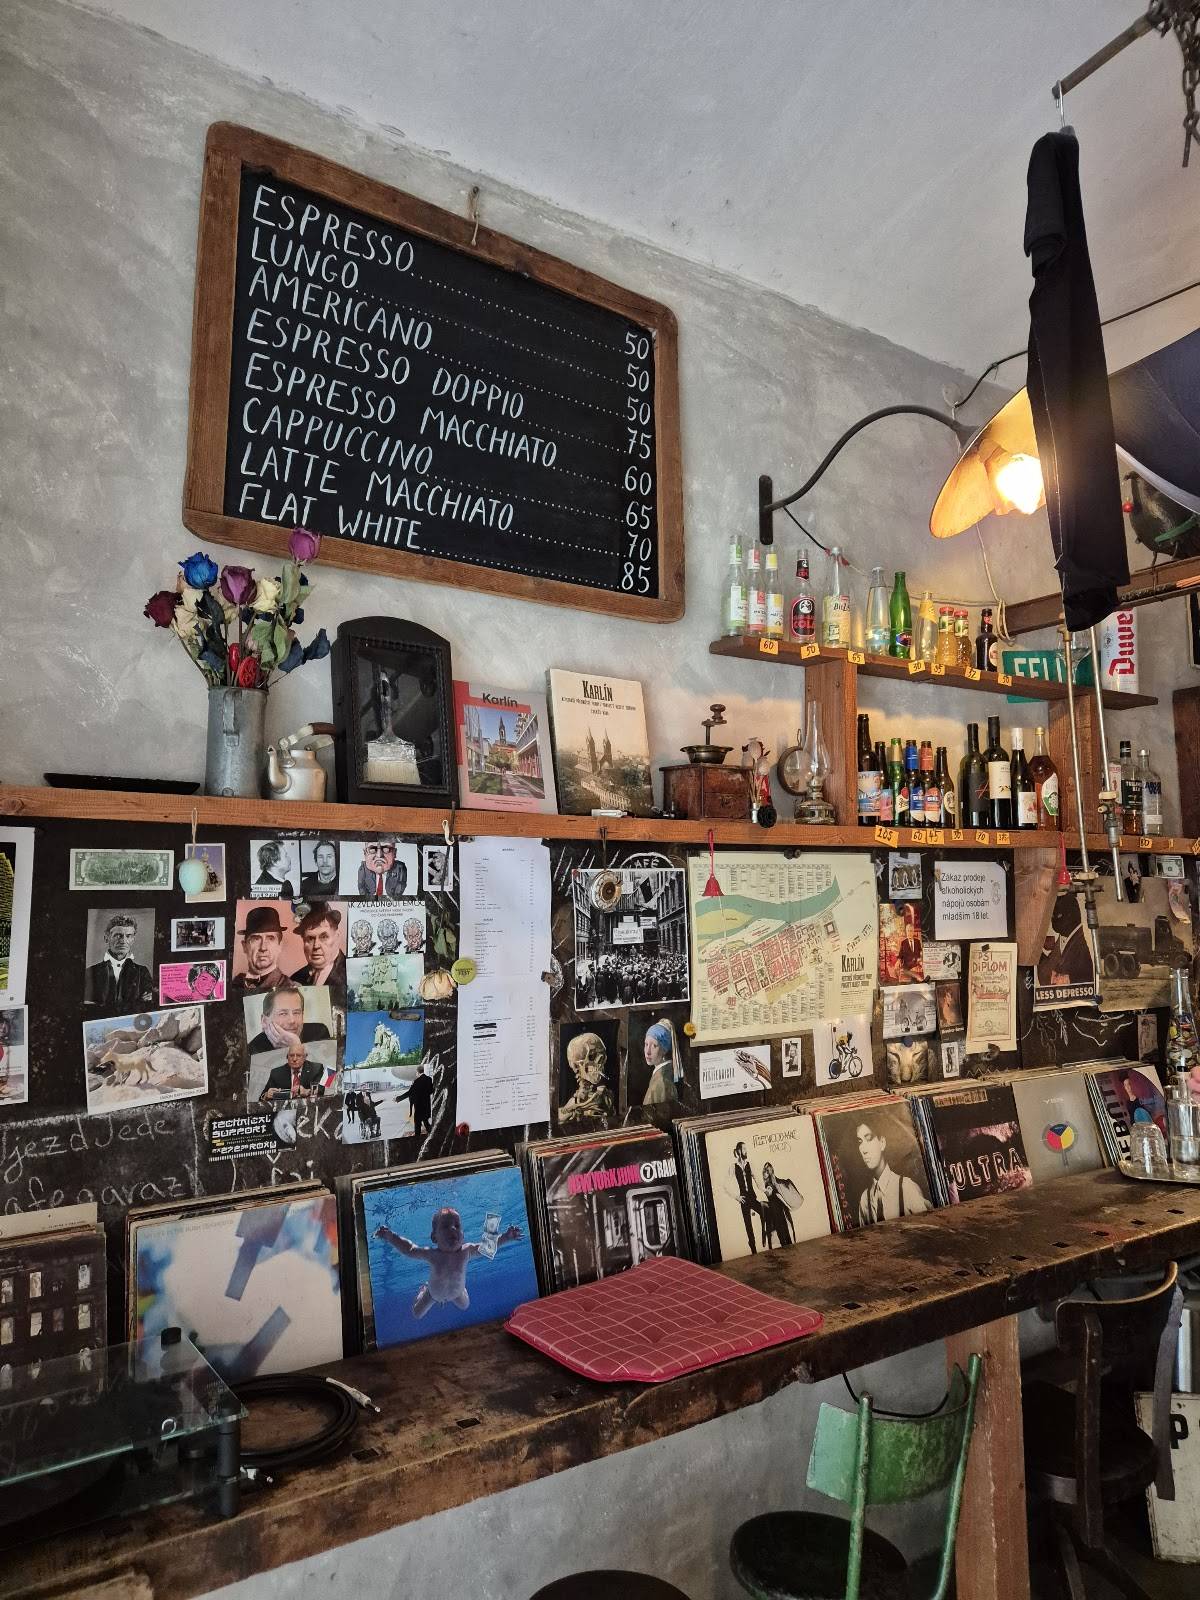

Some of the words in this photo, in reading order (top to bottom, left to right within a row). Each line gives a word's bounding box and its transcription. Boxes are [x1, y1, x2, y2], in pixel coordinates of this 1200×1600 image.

[251, 226, 359, 289] LUNGO
[626, 362, 650, 392] 50
[253, 184, 414, 272] ESPRESSO
[623, 331, 650, 360] 50
[246, 307, 410, 385] ESPRESSO
[432, 367, 524, 418] DOPPIO
[627, 426, 653, 459] 75
[248, 264, 433, 350] AMERICANO
[626, 396, 651, 425] 50
[245, 352, 396, 424] ESPRESSO
[420, 406, 557, 467] MACCHIATO
[624, 465, 652, 496] 60
[240, 441, 340, 494] LATTE
[365, 470, 514, 531] MACCHIATO
[628, 531, 652, 561] 70
[242, 396, 433, 475] CAPPUCCINO
[626, 501, 653, 530] 65
[239, 482, 319, 525] FLAT
[338, 504, 422, 549] WHITE
[621, 561, 651, 593] 85
[763, 640, 774, 650] 60
[482, 692, 518, 708] Karlín
[941, 871, 961, 882] Zákaz
[963, 871, 986, 884] prodeje
[942, 898, 965, 910] nápojů
[965, 898, 990, 908] osobám
[942, 910, 971, 921] mladším
[972, 911, 980, 920] 18
[1036, 989, 1055, 1000] LESS
[1056, 986, 1094, 999] DEPRESSO
[652, 1157, 678, 1179] TRAIN
[949, 1147, 1024, 1191] ULTRA
